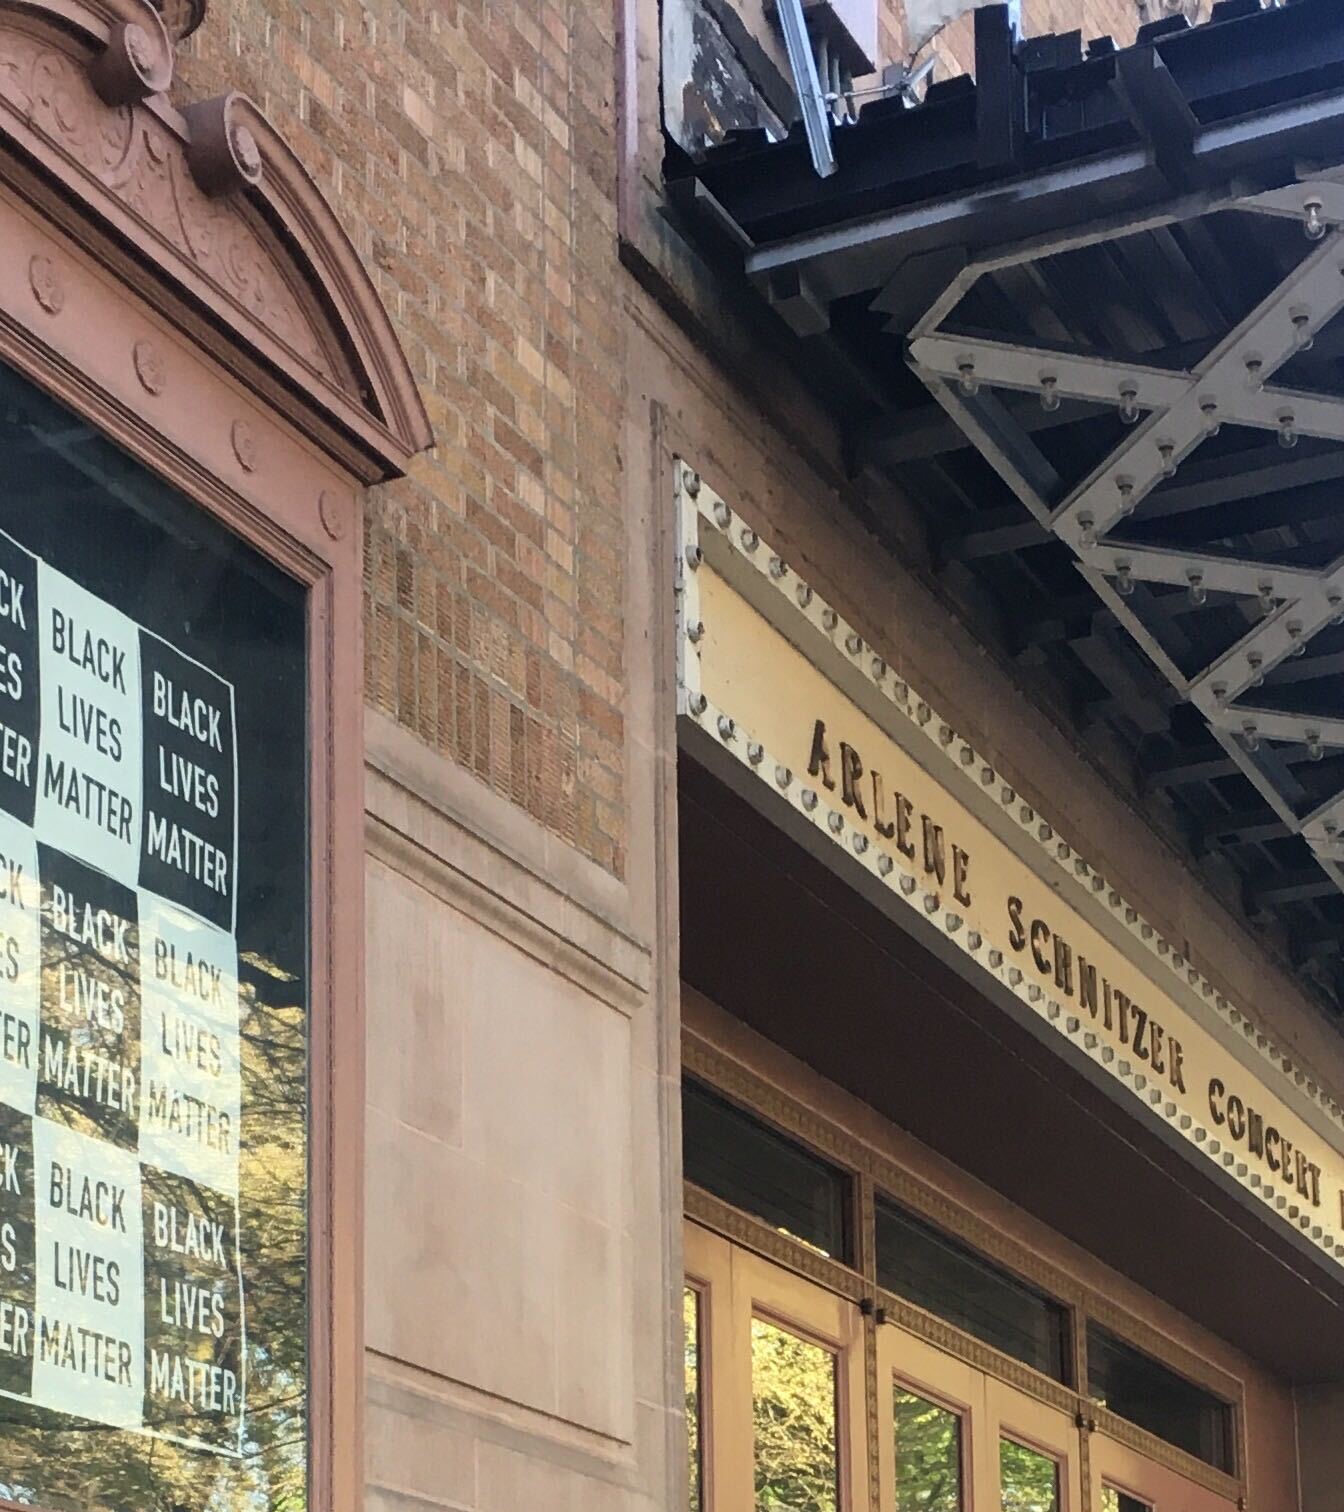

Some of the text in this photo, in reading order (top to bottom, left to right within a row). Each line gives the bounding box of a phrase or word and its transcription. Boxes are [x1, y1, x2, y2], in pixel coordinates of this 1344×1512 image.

[52, 608, 127, 696] BLACK
[57, 685, 123, 763] LIVES
[153, 671, 223, 753] BLACK
[44, 753, 133, 845] MATTER
[158, 745, 220, 818] LIVES
[147, 810, 227, 896] MATTER
[52, 884, 129, 965] BLACK
[59, 963, 125, 1035] LIVES
[154, 936, 224, 1010] BLACK
[807, 719, 973, 909] ARLENE
[1008, 895, 1187, 1095] SCHNITZER
[1208, 1078, 1322, 1208] CONCERT
[44, 1034, 136, 1118] MATTER
[161, 1011, 222, 1078] LIVES
[147, 1079, 231, 1156] MATTER
[49, 1161, 127, 1234] BLACK
[154, 1202, 228, 1269] BLACK
[53, 1241, 121, 1307] LIVES
[160, 1277, 226, 1339] LIVES
[39, 1315, 134, 1388] MATTER
[149, 1349, 238, 1415] MATTER
